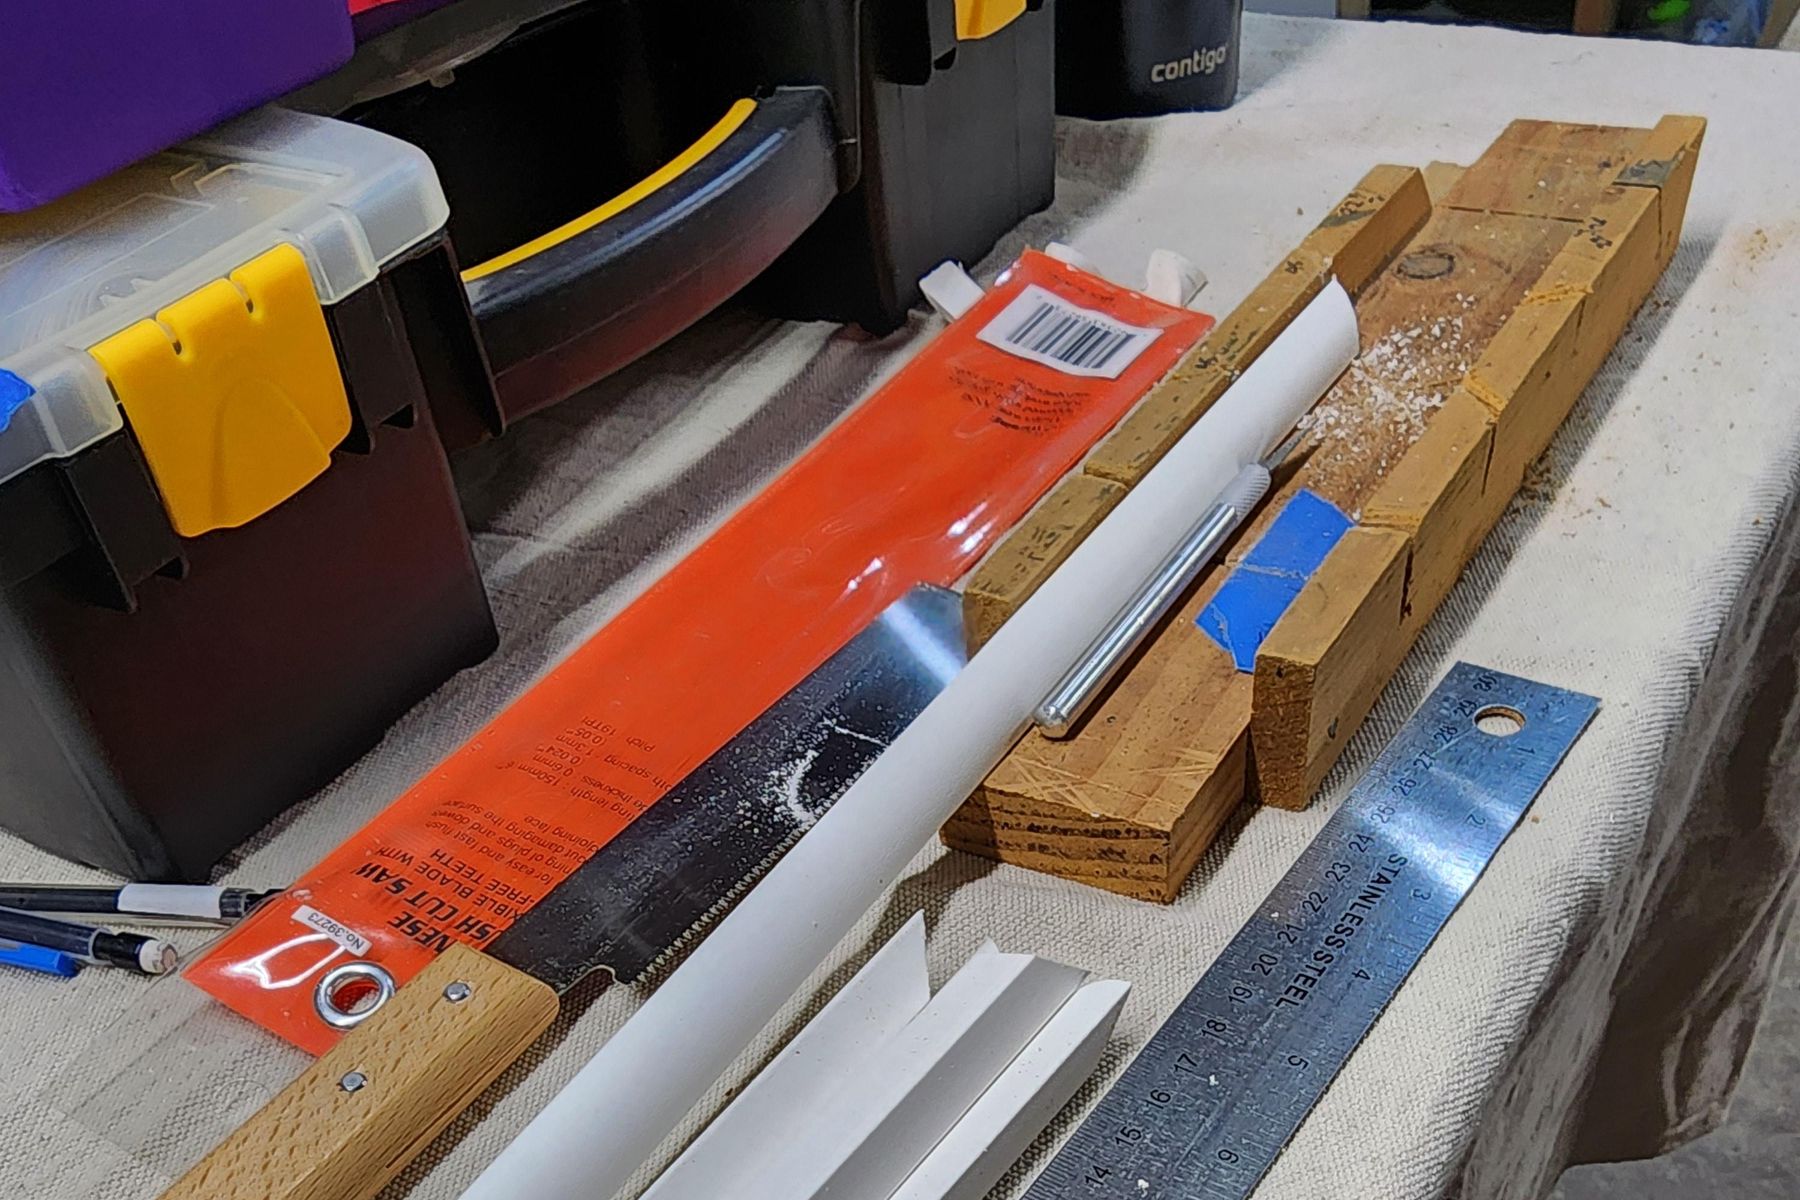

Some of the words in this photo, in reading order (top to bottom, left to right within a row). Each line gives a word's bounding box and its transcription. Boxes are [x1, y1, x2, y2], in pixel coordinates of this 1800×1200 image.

[1151, 46, 1226, 83] contigo
[582, 716, 617, 736] 19TPI
[626, 736, 656, 753] Pitch
[518, 764, 561, 787] 150mm
[604, 754, 650, 779] spacing
[570, 786, 607, 809] length
[582, 775, 633, 803] thickness
[484, 810, 505, 827] the
[524, 815, 549, 831] face
[1466, 813, 1487, 829] 2
[454, 829, 478, 849] fast
[469, 821, 496, 839] and
[505, 822, 564, 853] damaging
[374, 846, 415, 866] WITH
[478, 846, 505, 862] and
[498, 836, 532, 857] plugs
[530, 851, 545, 863] of
[430, 849, 486, 885] TEETH
[506, 856, 535, 877] easy
[349, 863, 414, 894] SAW
[414, 860, 474, 899] BLADE
[535, 870, 554, 886] for
[1324, 853, 1408, 950] STAINLESS
[1413, 888, 1431, 901] 3
[404, 890, 459, 922] CUT
[308, 912, 366, 950] No.39273
[387, 911, 458, 953] NESE
[1085, 1165, 1112, 1186] 14
[1115, 1126, 1141, 1147] 15
[1147, 1089, 1171, 1110] 16
[1173, 1053, 1198, 1074] 17
[1201, 1019, 1227, 1039] 18
[1229, 986, 1253, 1005] 19
[1252, 954, 1278, 976] 20
[1277, 923, 1302, 944] 21
[1302, 891, 1329, 913] 22
[1325, 862, 1351, 882] 23
[1348, 833, 1374, 853] 24
[1392, 777, 1417, 797] 26
[1413, 749, 1437, 770] 27
[1434, 723, 1458, 744] 28
[1453, 699, 1477, 718] 29
[1275, 950, 1334, 1008] STEEL
[1352, 969, 1372, 981] 4
[1287, 1054, 1309, 1070] 5
[1218, 1149, 1239, 1164] 6
